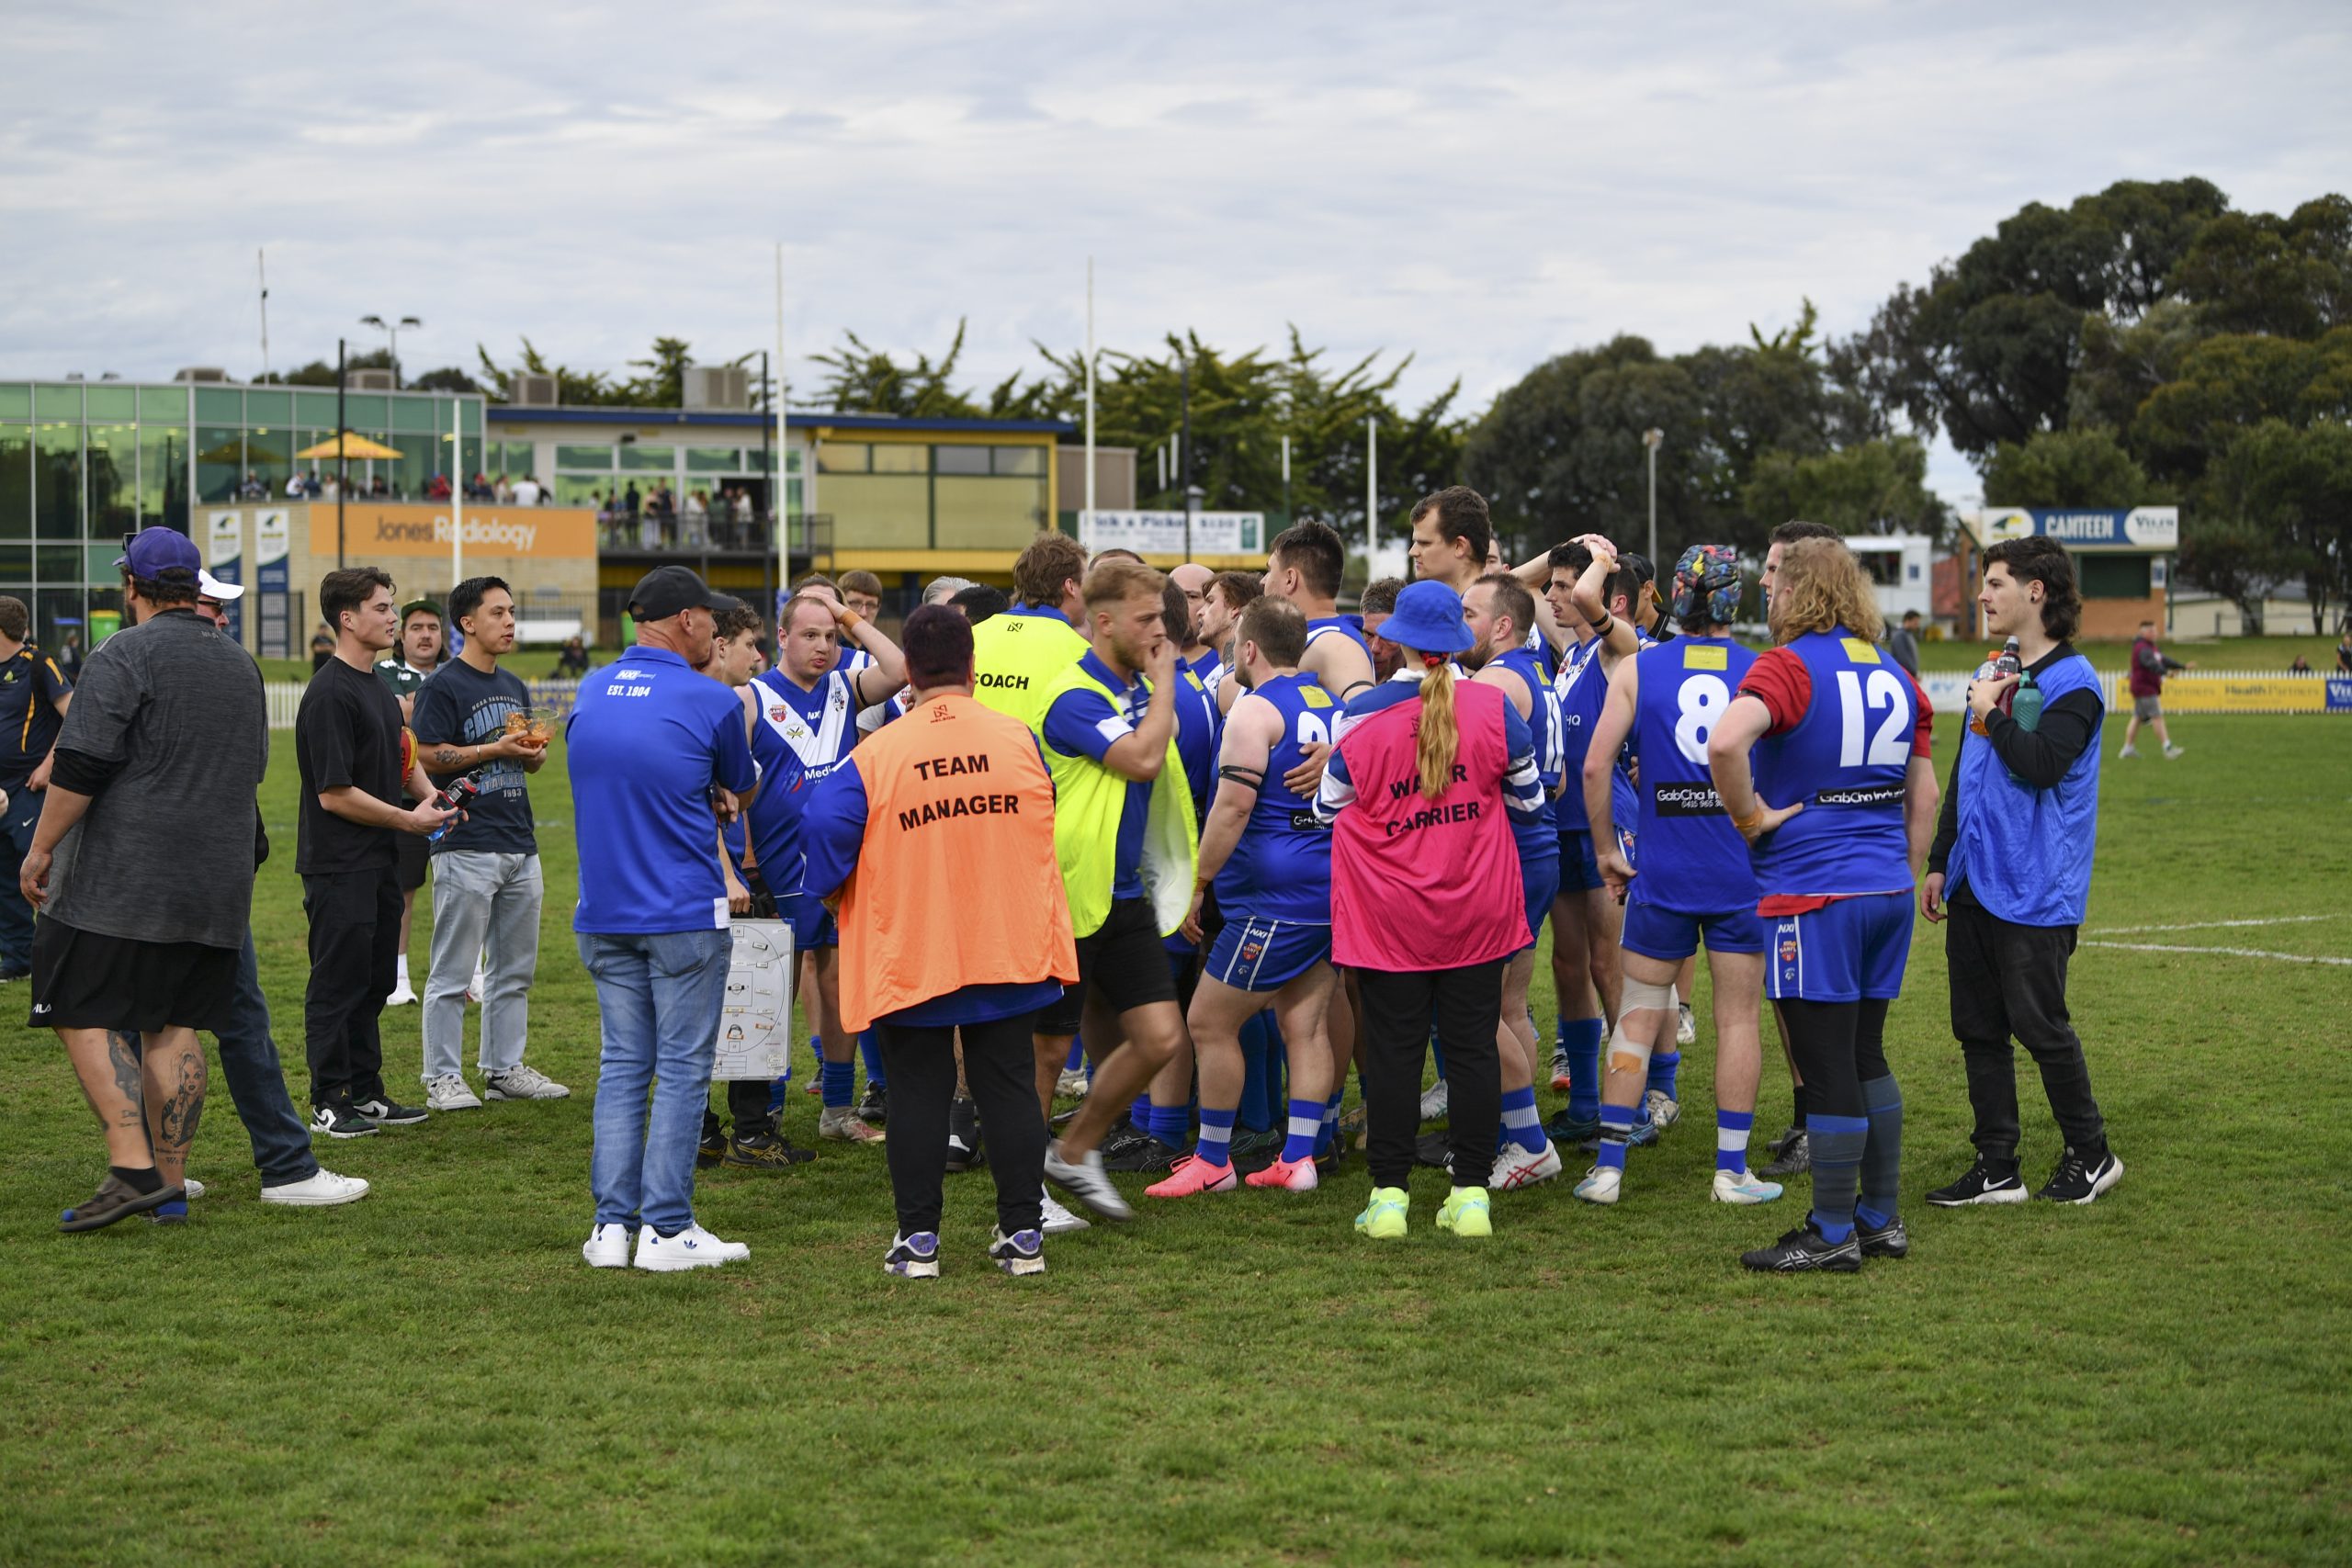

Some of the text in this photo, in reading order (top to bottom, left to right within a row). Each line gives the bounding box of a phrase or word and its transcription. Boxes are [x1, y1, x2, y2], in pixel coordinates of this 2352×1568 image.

[2045, 513, 2115, 539] CANTEEN
[606, 684, 625, 696] EST.
[975, 672, 1029, 690] OACH
[463, 702, 519, 743] CHAMP
[1675, 673, 1730, 766] 8
[1837, 670, 1910, 768] 12
[913, 753, 990, 781] TEAM
[503, 788, 522, 798] 1993
[1389, 764, 1469, 800] WAR
[1657, 788, 1705, 802] GabCha
[899, 794, 1020, 831] MANAGER
[1385, 801, 1481, 838] CARRIER
[1250, 928, 1268, 939] NXI
[1778, 923, 1794, 933] NXI
